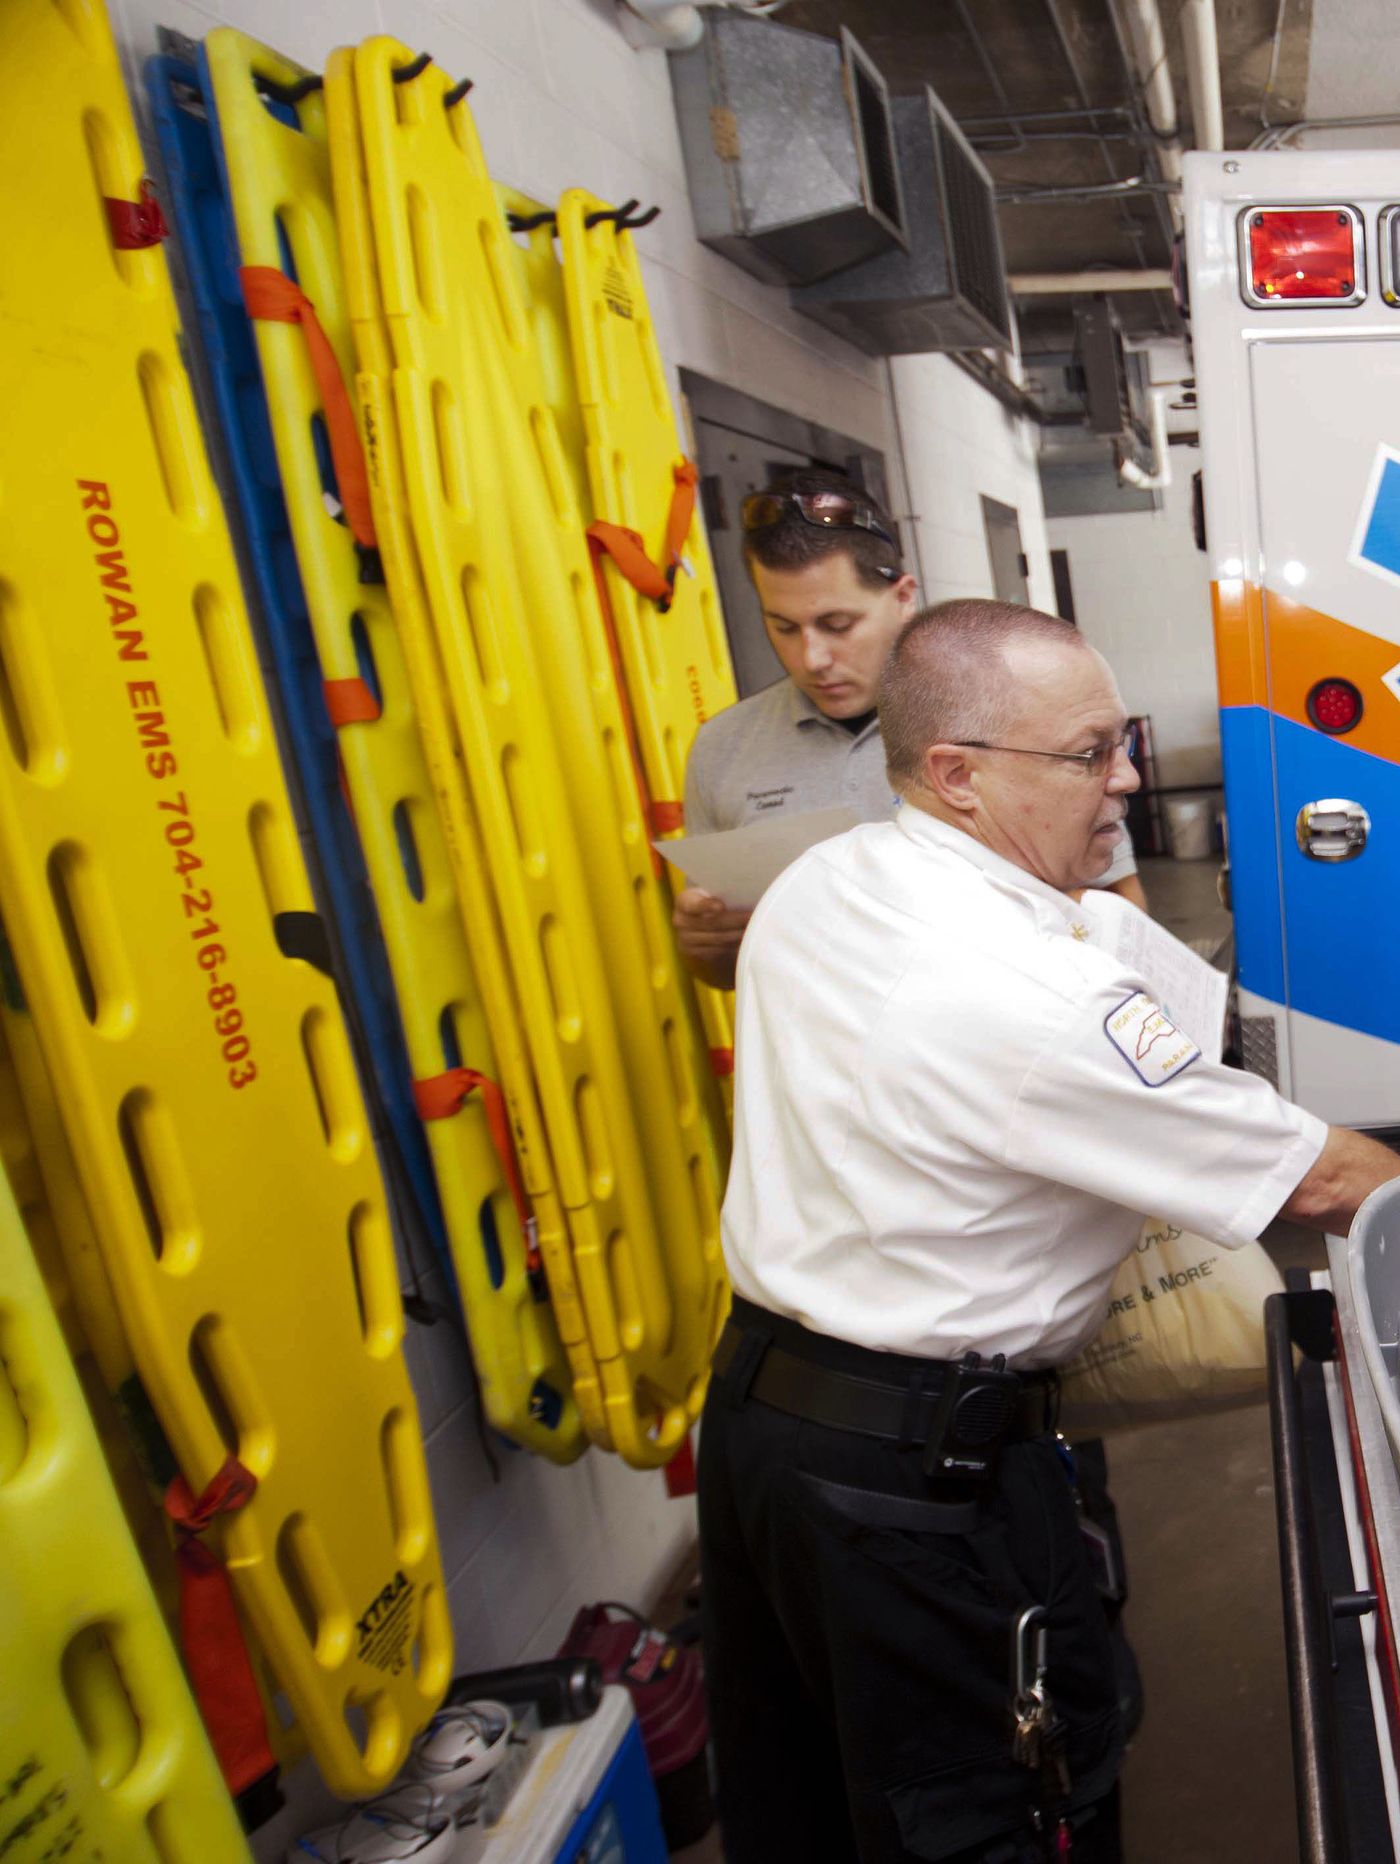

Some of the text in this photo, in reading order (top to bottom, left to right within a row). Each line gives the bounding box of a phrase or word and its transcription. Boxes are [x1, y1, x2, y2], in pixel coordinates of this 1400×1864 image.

[75, 478, 258, 1090] ROWAN EMS 704-216-8903
[356, 1571, 411, 1643] XTRA
